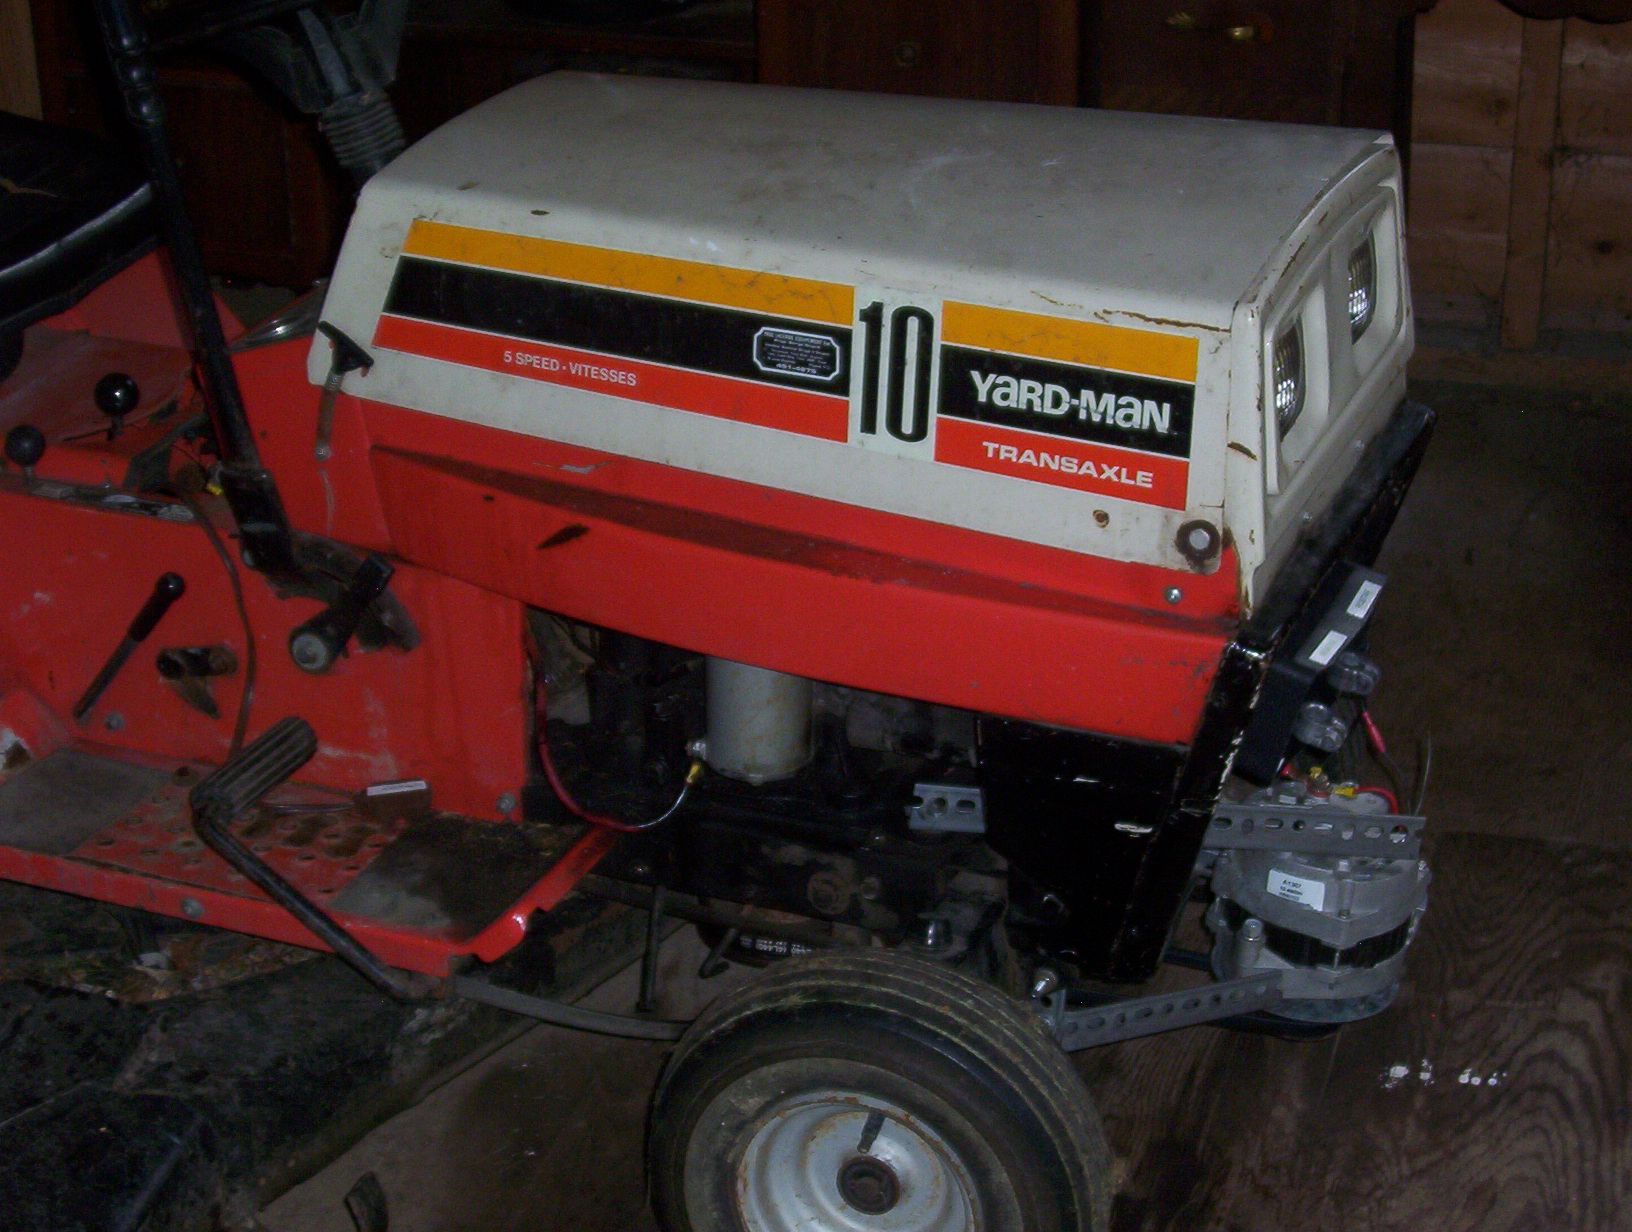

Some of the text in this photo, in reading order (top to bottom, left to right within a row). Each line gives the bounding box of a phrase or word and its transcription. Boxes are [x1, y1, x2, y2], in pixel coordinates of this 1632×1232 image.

[504, 351, 637, 386] 5 SPEED VITESSES
[859, 301, 934, 442] 10
[983, 441, 1154, 488] TRANSAXLE
